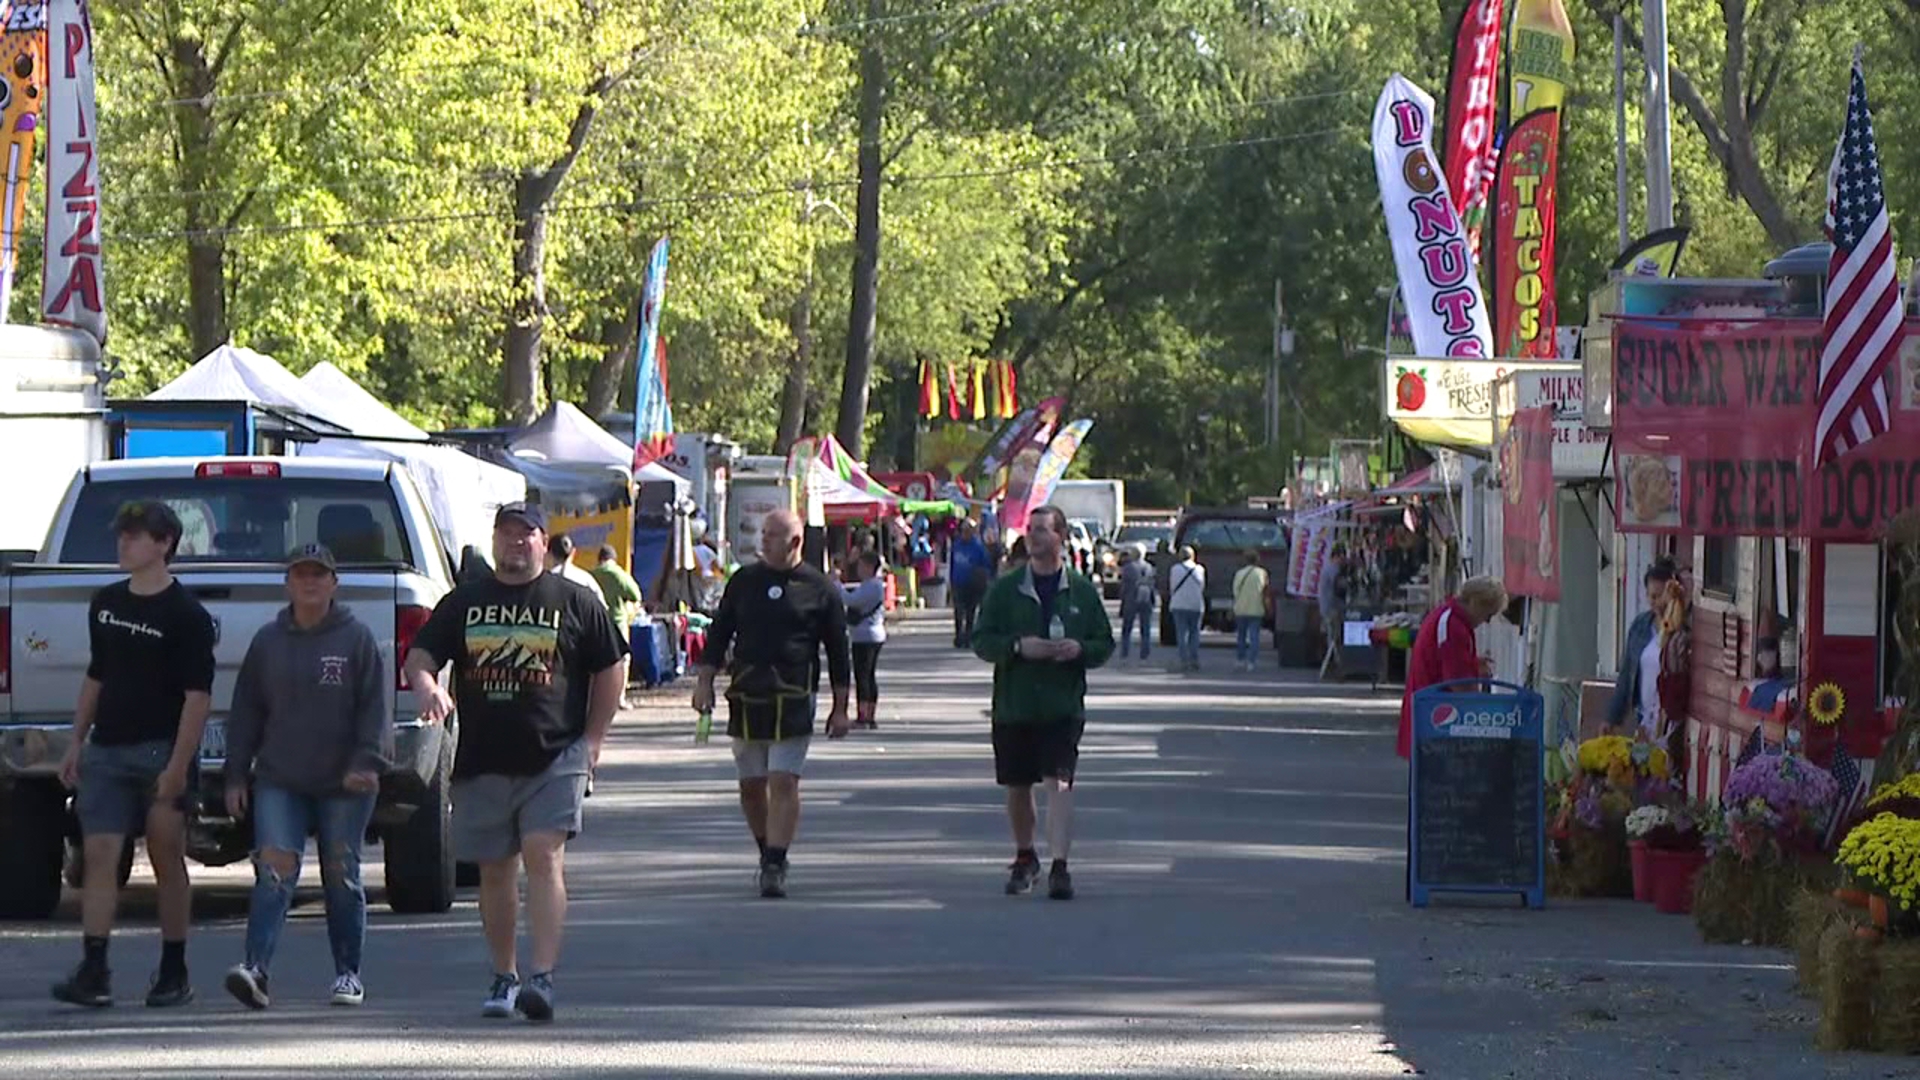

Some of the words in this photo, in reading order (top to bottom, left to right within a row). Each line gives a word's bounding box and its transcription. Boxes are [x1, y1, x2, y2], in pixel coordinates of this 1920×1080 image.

[47, 22, 102, 314] PIZZA
[1513, 175, 1543, 342] TACOS
[1617, 335, 1728, 406] SUGAR
[1448, 382, 1491, 415] FRESH
[1687, 458, 1801, 528] FRIED
[466, 604, 560, 629] DENALI
[482, 680, 521, 692] ALASKA
[1463, 708, 1522, 727] pepsi
